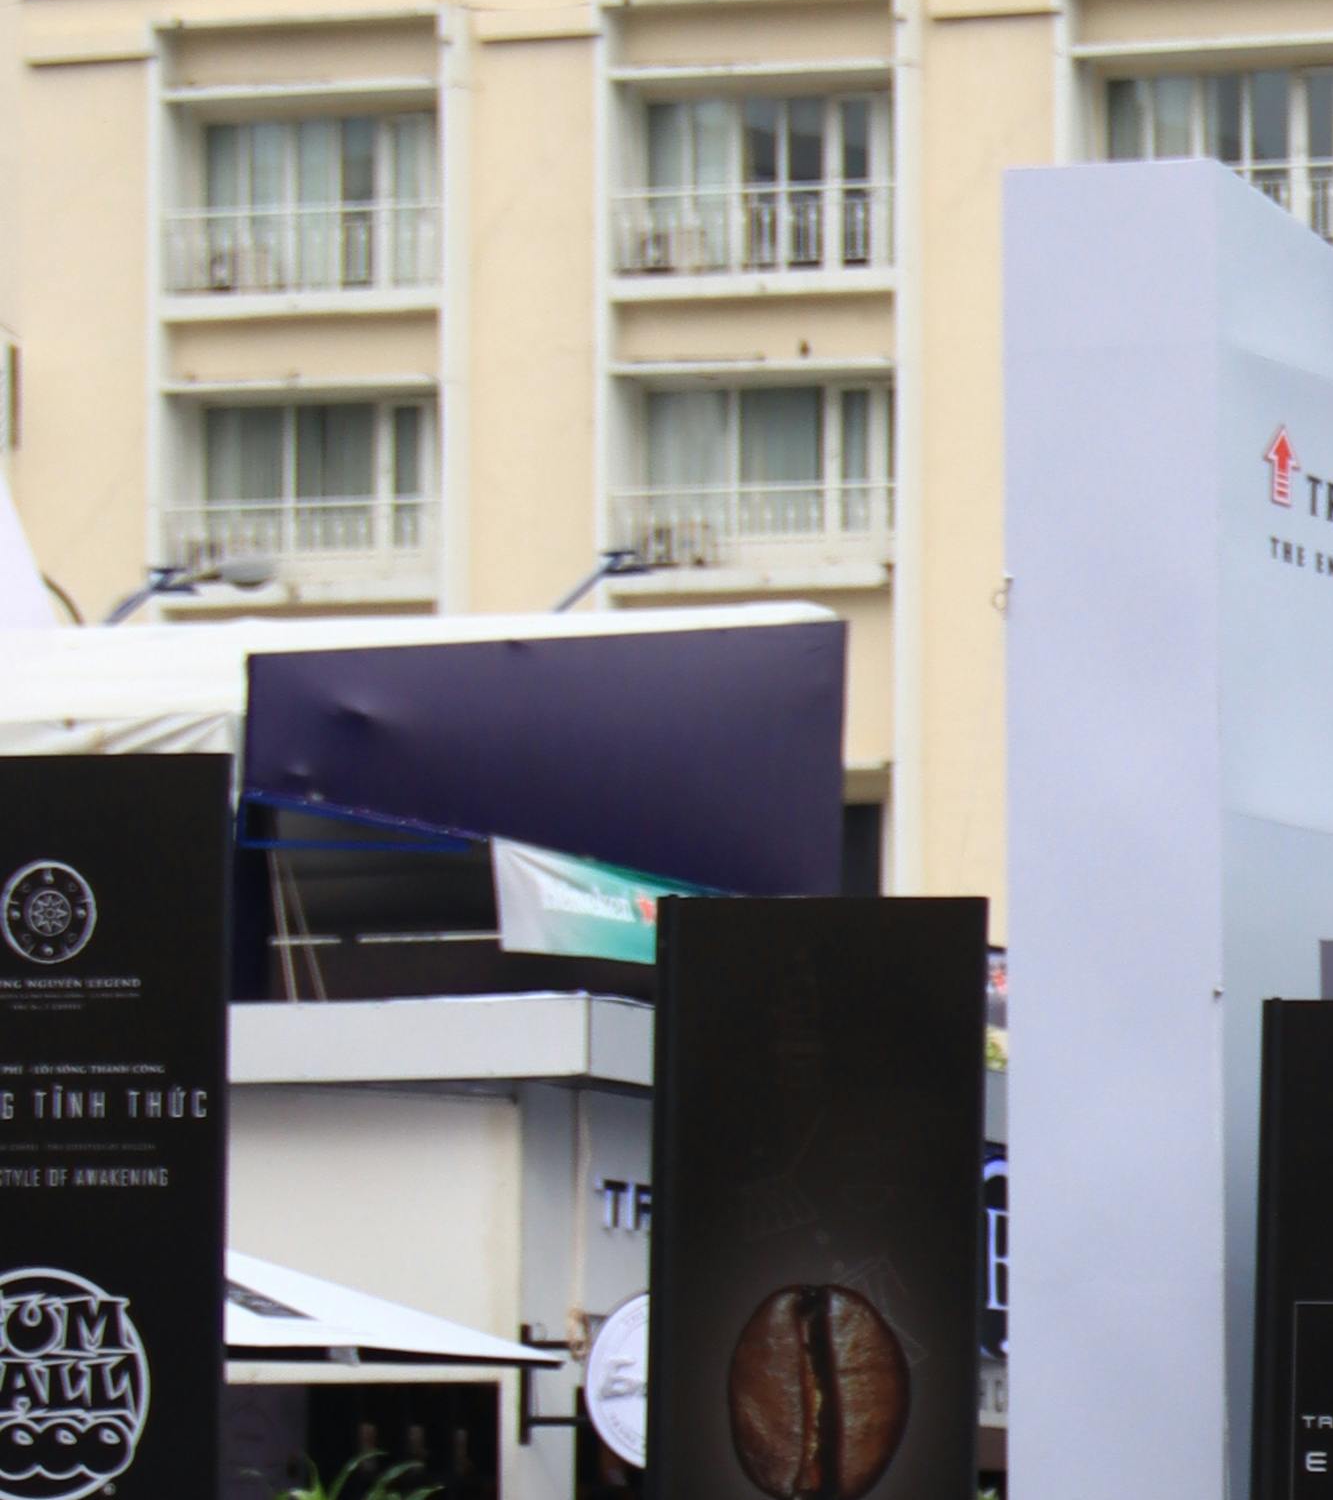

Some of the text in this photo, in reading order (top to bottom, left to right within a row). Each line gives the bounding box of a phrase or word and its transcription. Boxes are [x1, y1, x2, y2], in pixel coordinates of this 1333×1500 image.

[1269, 536, 1305, 567] THE
[48, 1169, 68, 1186] OF
[75, 1168, 168, 1186] AWAKENING
